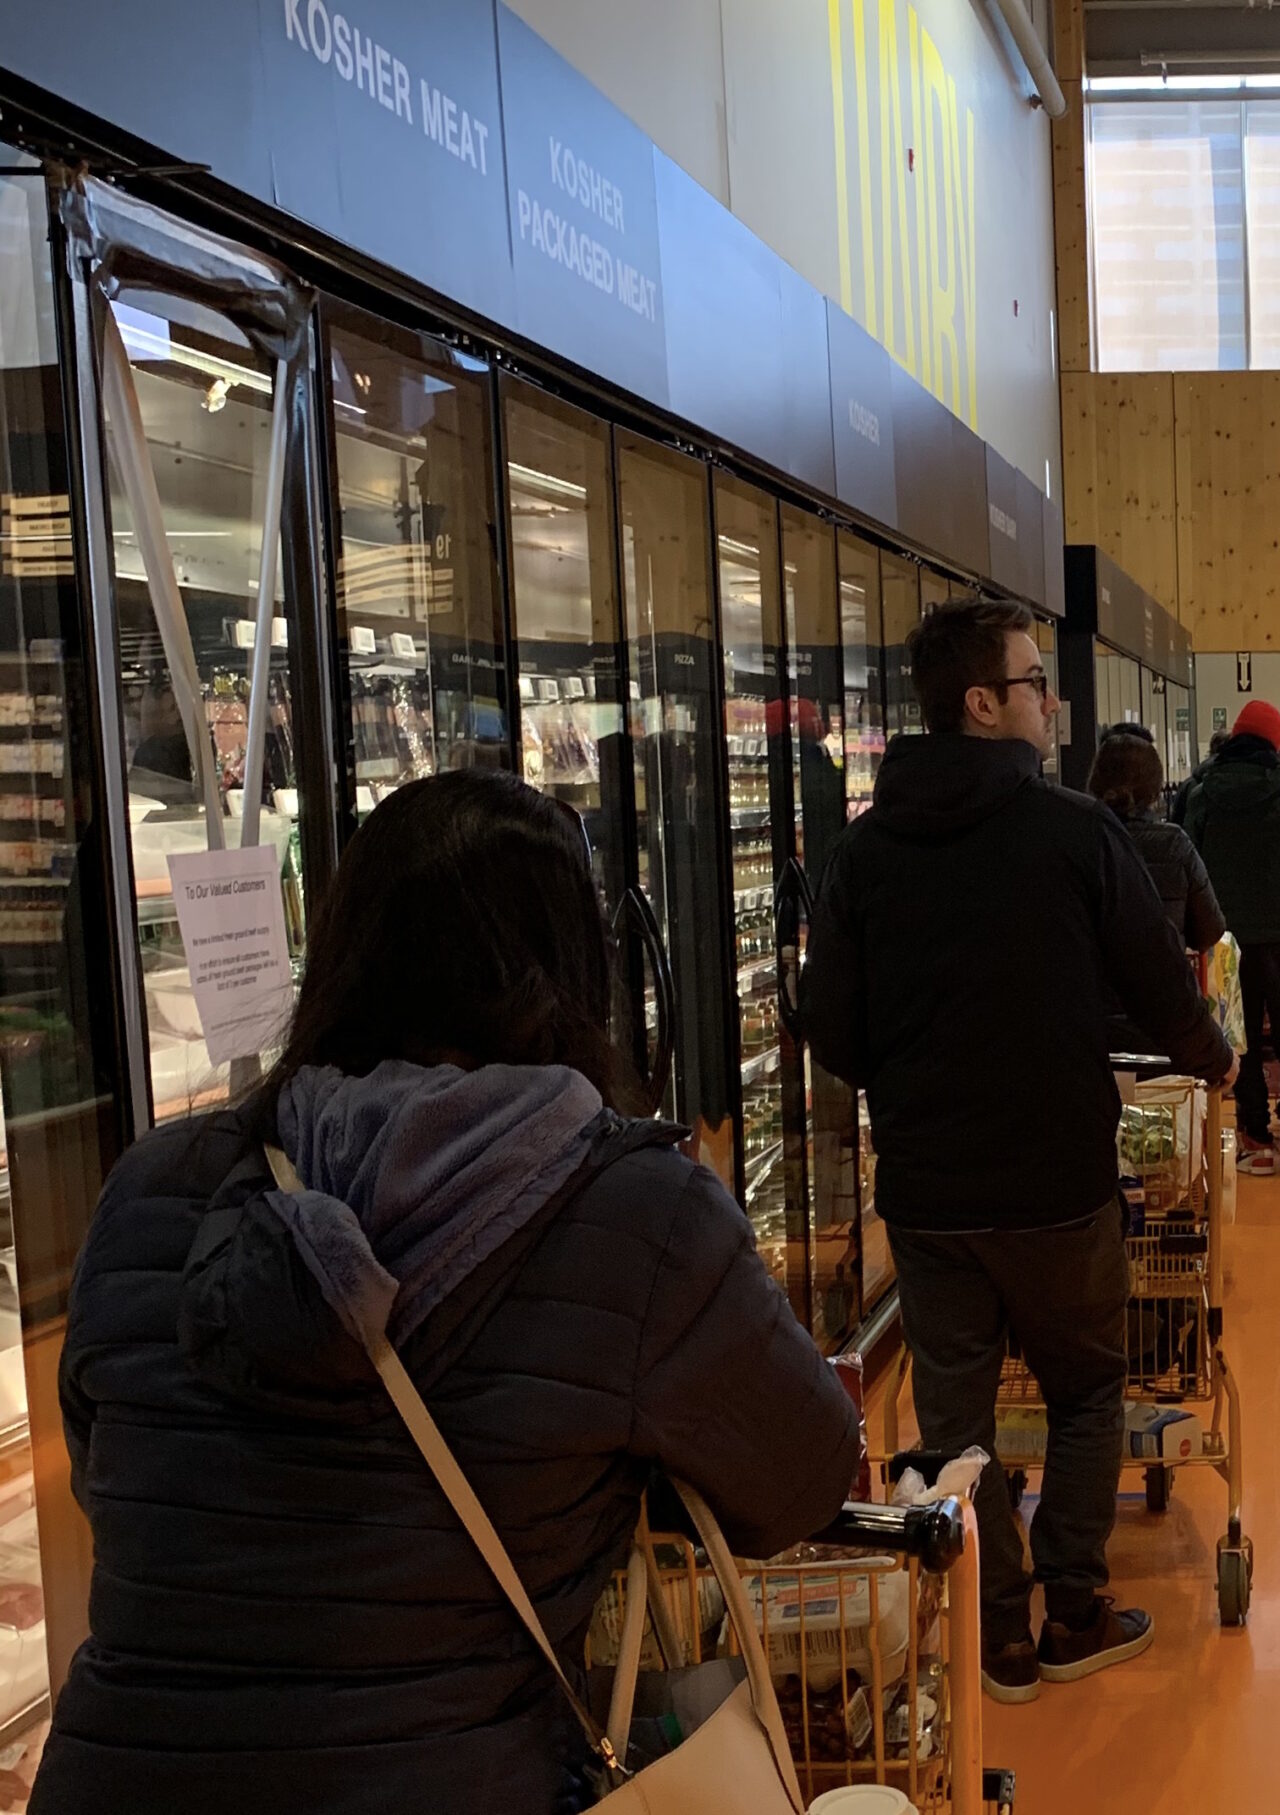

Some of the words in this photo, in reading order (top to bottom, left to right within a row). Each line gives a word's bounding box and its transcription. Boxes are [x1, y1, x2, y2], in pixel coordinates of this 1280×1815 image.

[283, 0, 413, 124] KOSHER
[420, 78, 488, 177] MEAT
[549, 136, 625, 234] KOSHER
[518, 189, 614, 293] PACKAGED
[617, 258, 657, 323] MEAT
[185, 886, 195, 900] To
[196, 884, 209, 899] Our
[210, 882, 232, 897] Valued
[233, 879, 266, 894] Customers
